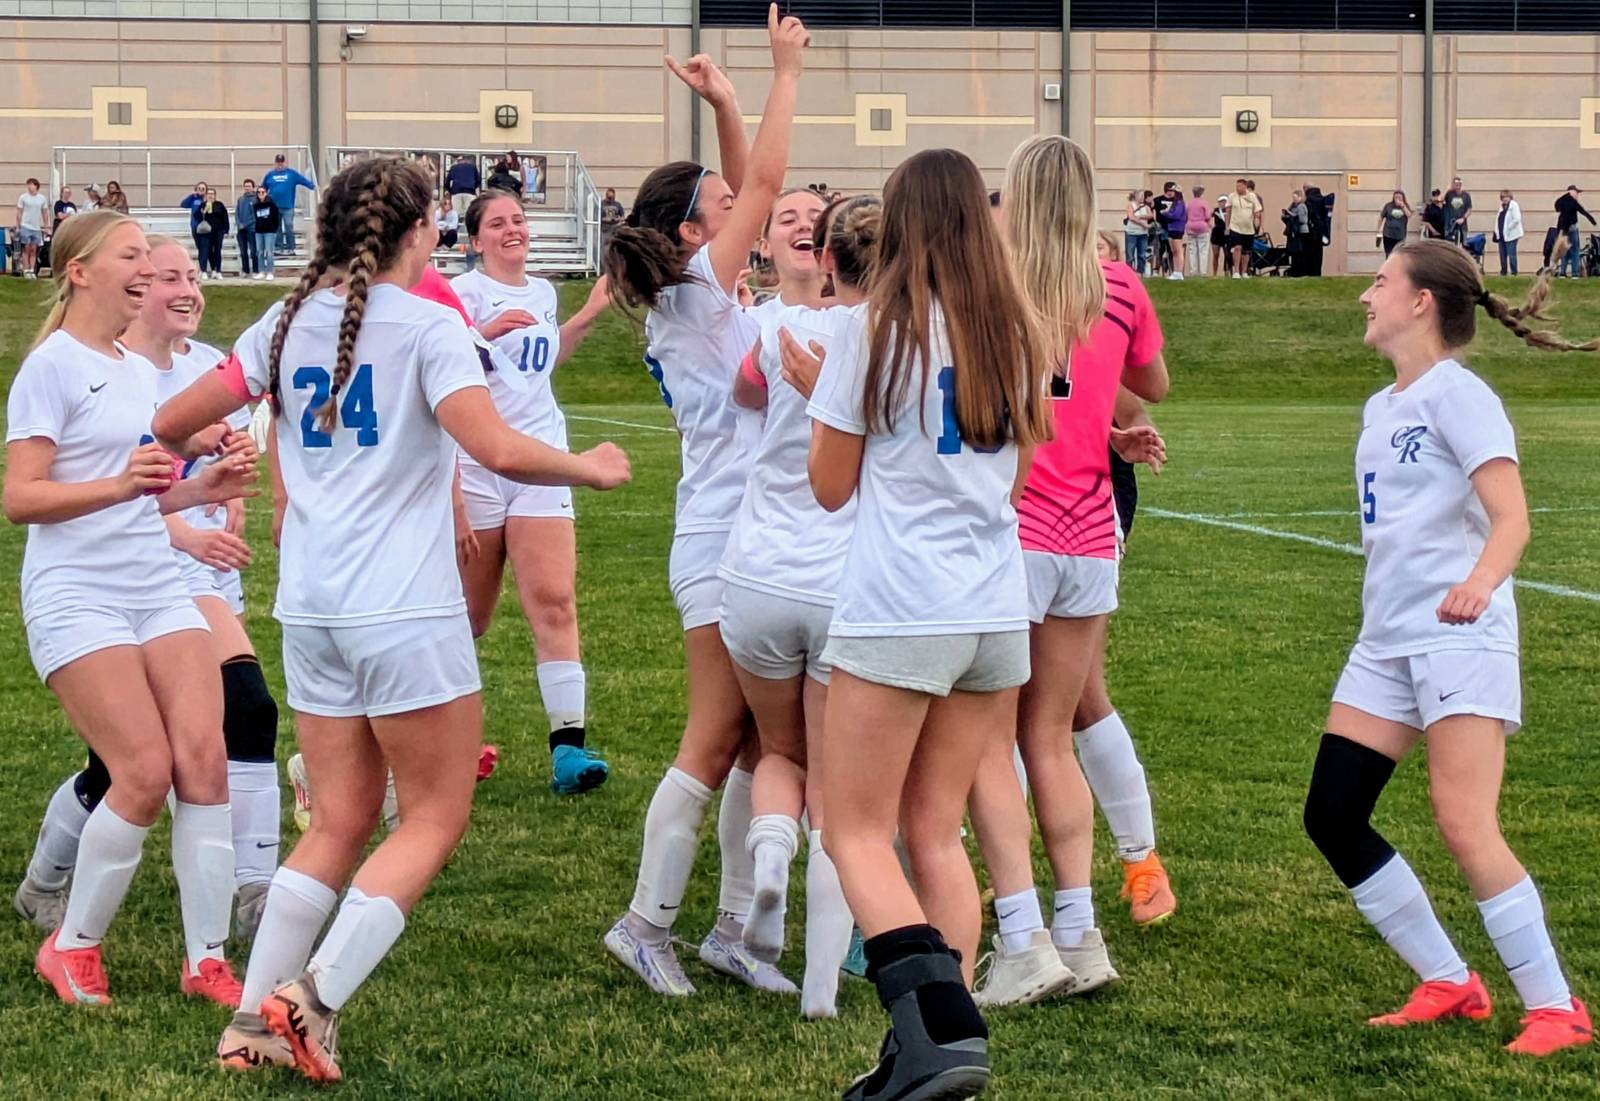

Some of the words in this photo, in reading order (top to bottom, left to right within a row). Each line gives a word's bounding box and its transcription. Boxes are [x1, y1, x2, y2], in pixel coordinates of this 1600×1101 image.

[517, 335, 549, 372] 10
[292, 363, 379, 448] 24
[1363, 471, 1377, 525] 5
